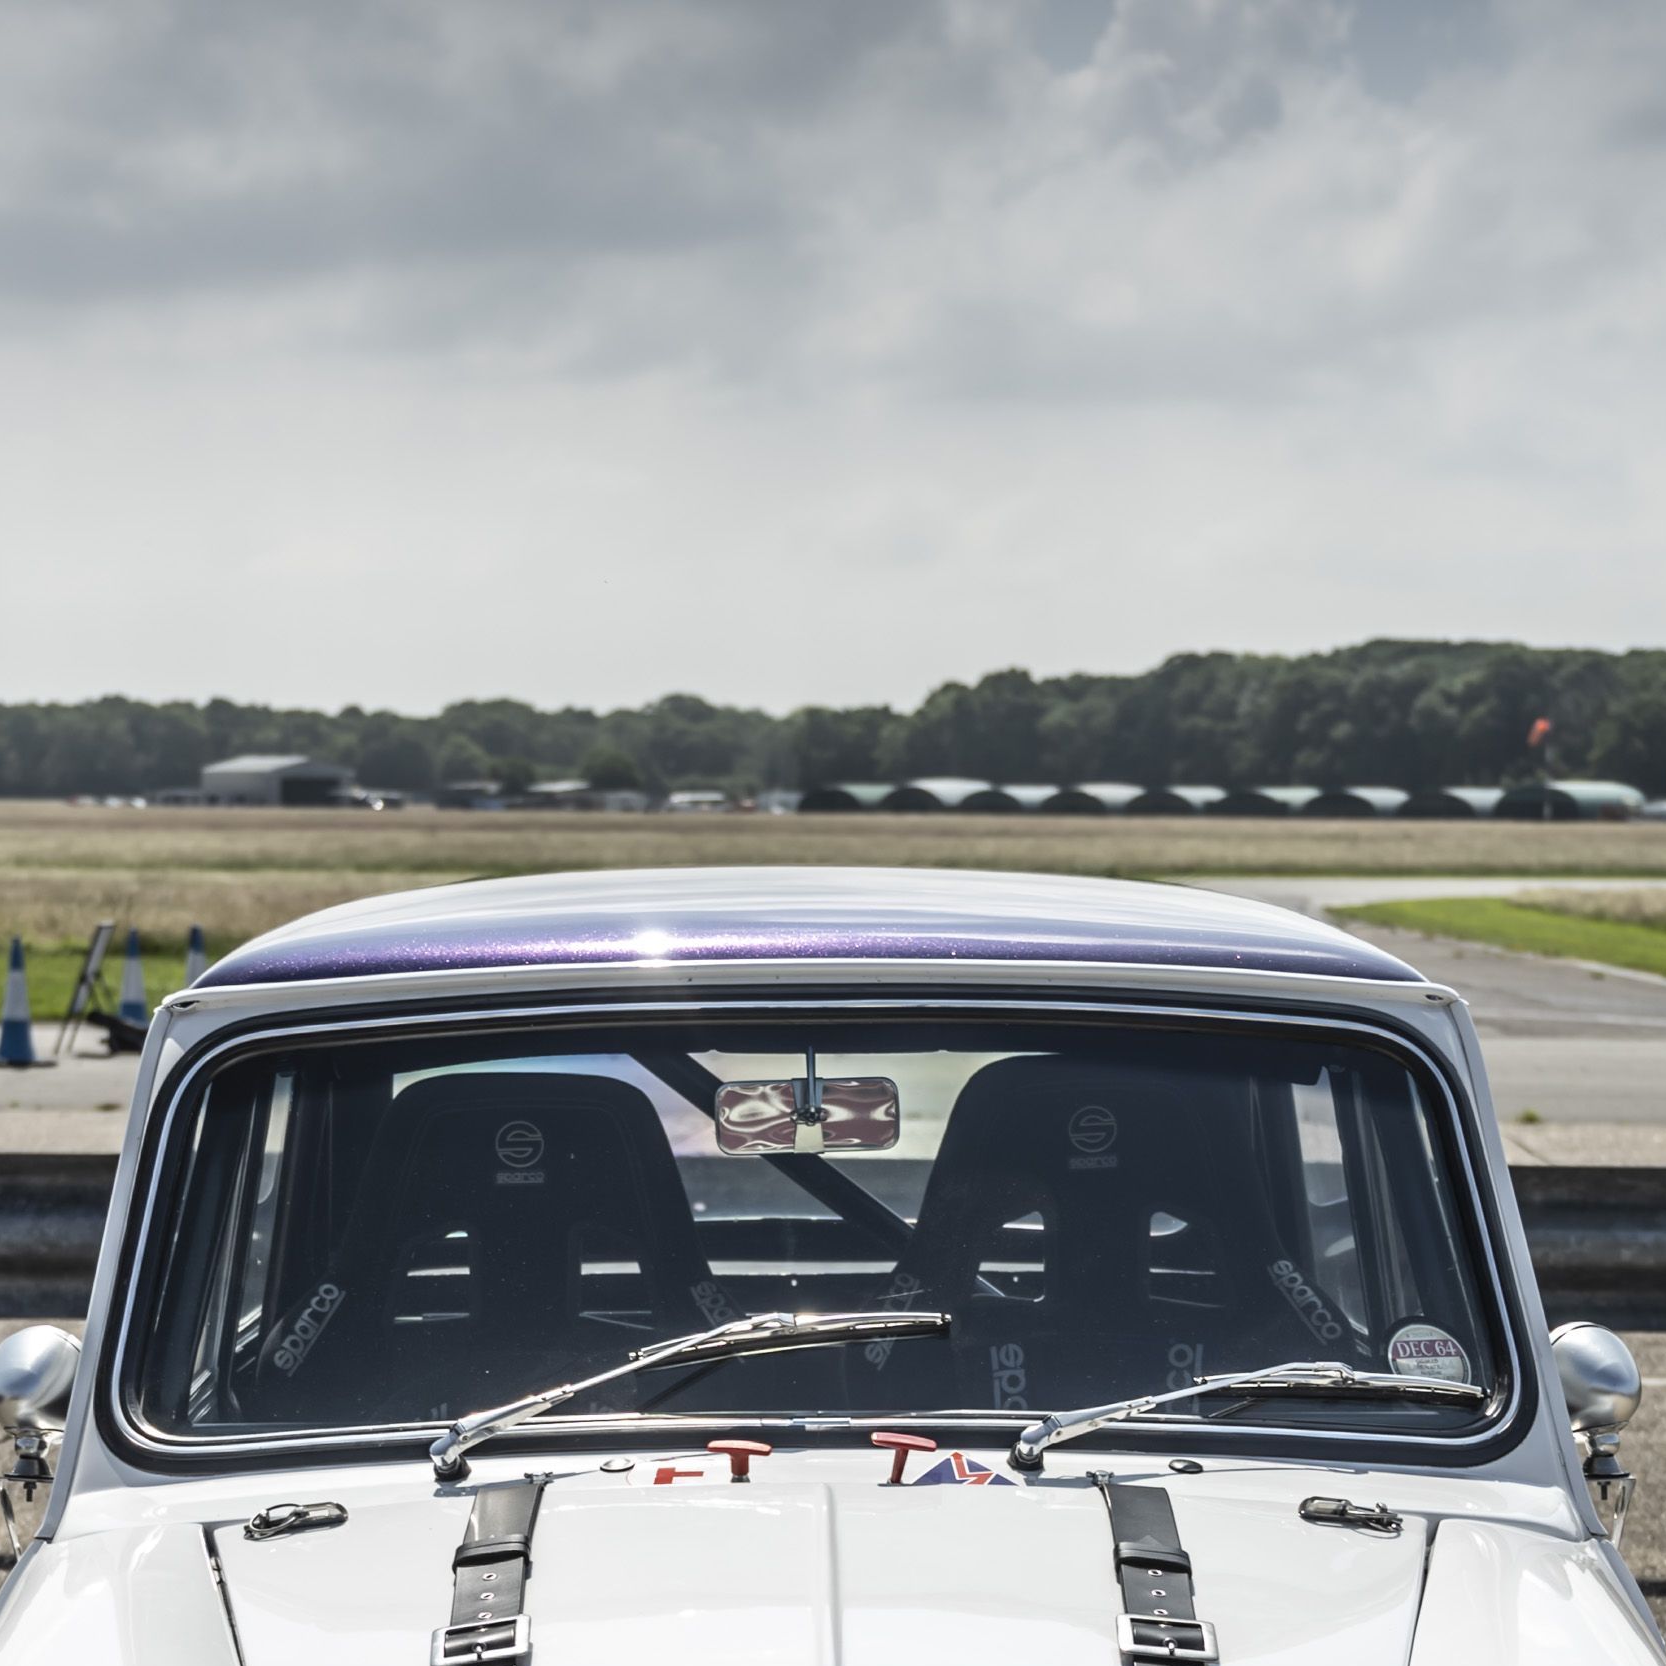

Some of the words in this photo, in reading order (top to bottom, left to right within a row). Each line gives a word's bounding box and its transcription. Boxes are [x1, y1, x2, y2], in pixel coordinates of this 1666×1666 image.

[496, 1172, 545, 1184] sparco
[1272, 1259, 1342, 1340] sparco
[273, 1283, 341, 1371] sparco
[1396, 1340, 1433, 1358] DEC
[1434, 1340, 1457, 1356] 64
